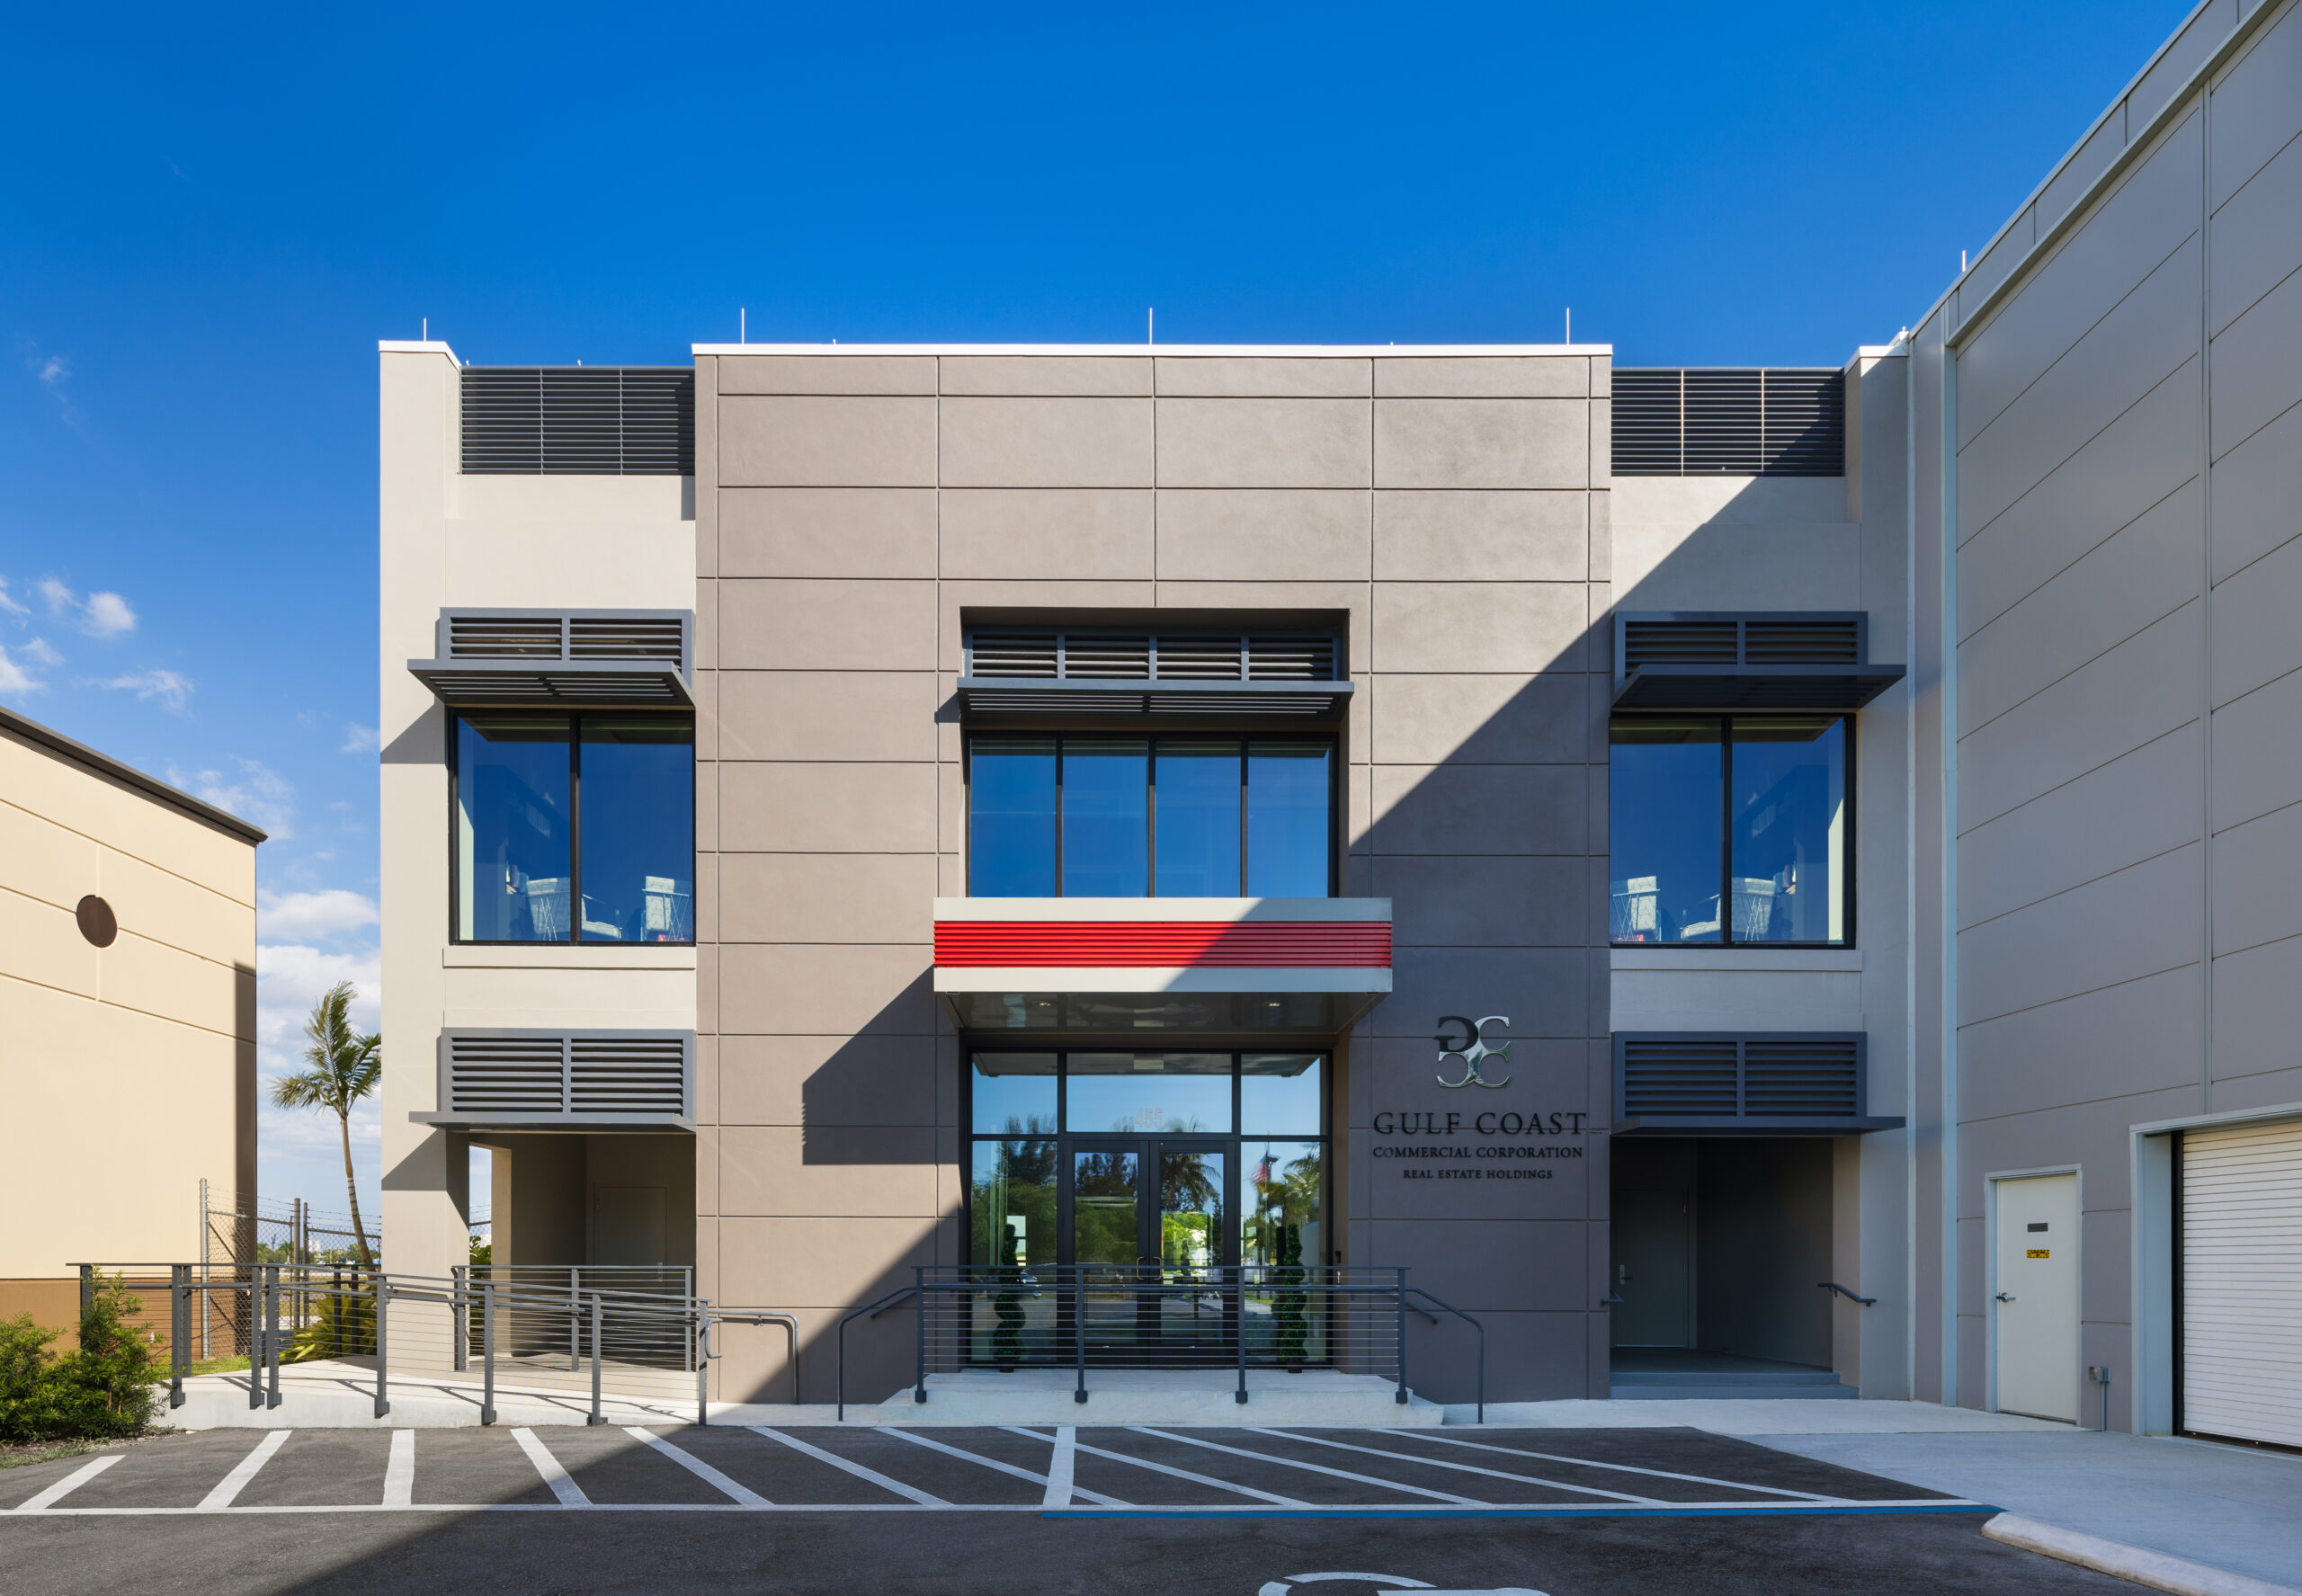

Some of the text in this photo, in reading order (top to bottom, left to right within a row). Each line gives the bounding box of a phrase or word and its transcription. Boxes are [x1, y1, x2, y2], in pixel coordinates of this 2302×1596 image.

[1134, 1108, 1164, 1128] 455
[1373, 1112, 1587, 1135] GULF COAST
[1372, 1146, 1583, 1158] COMMERCIAL CORPORATION
[1403, 1170, 1553, 1179] REAL ESTATE HOLDINGS
